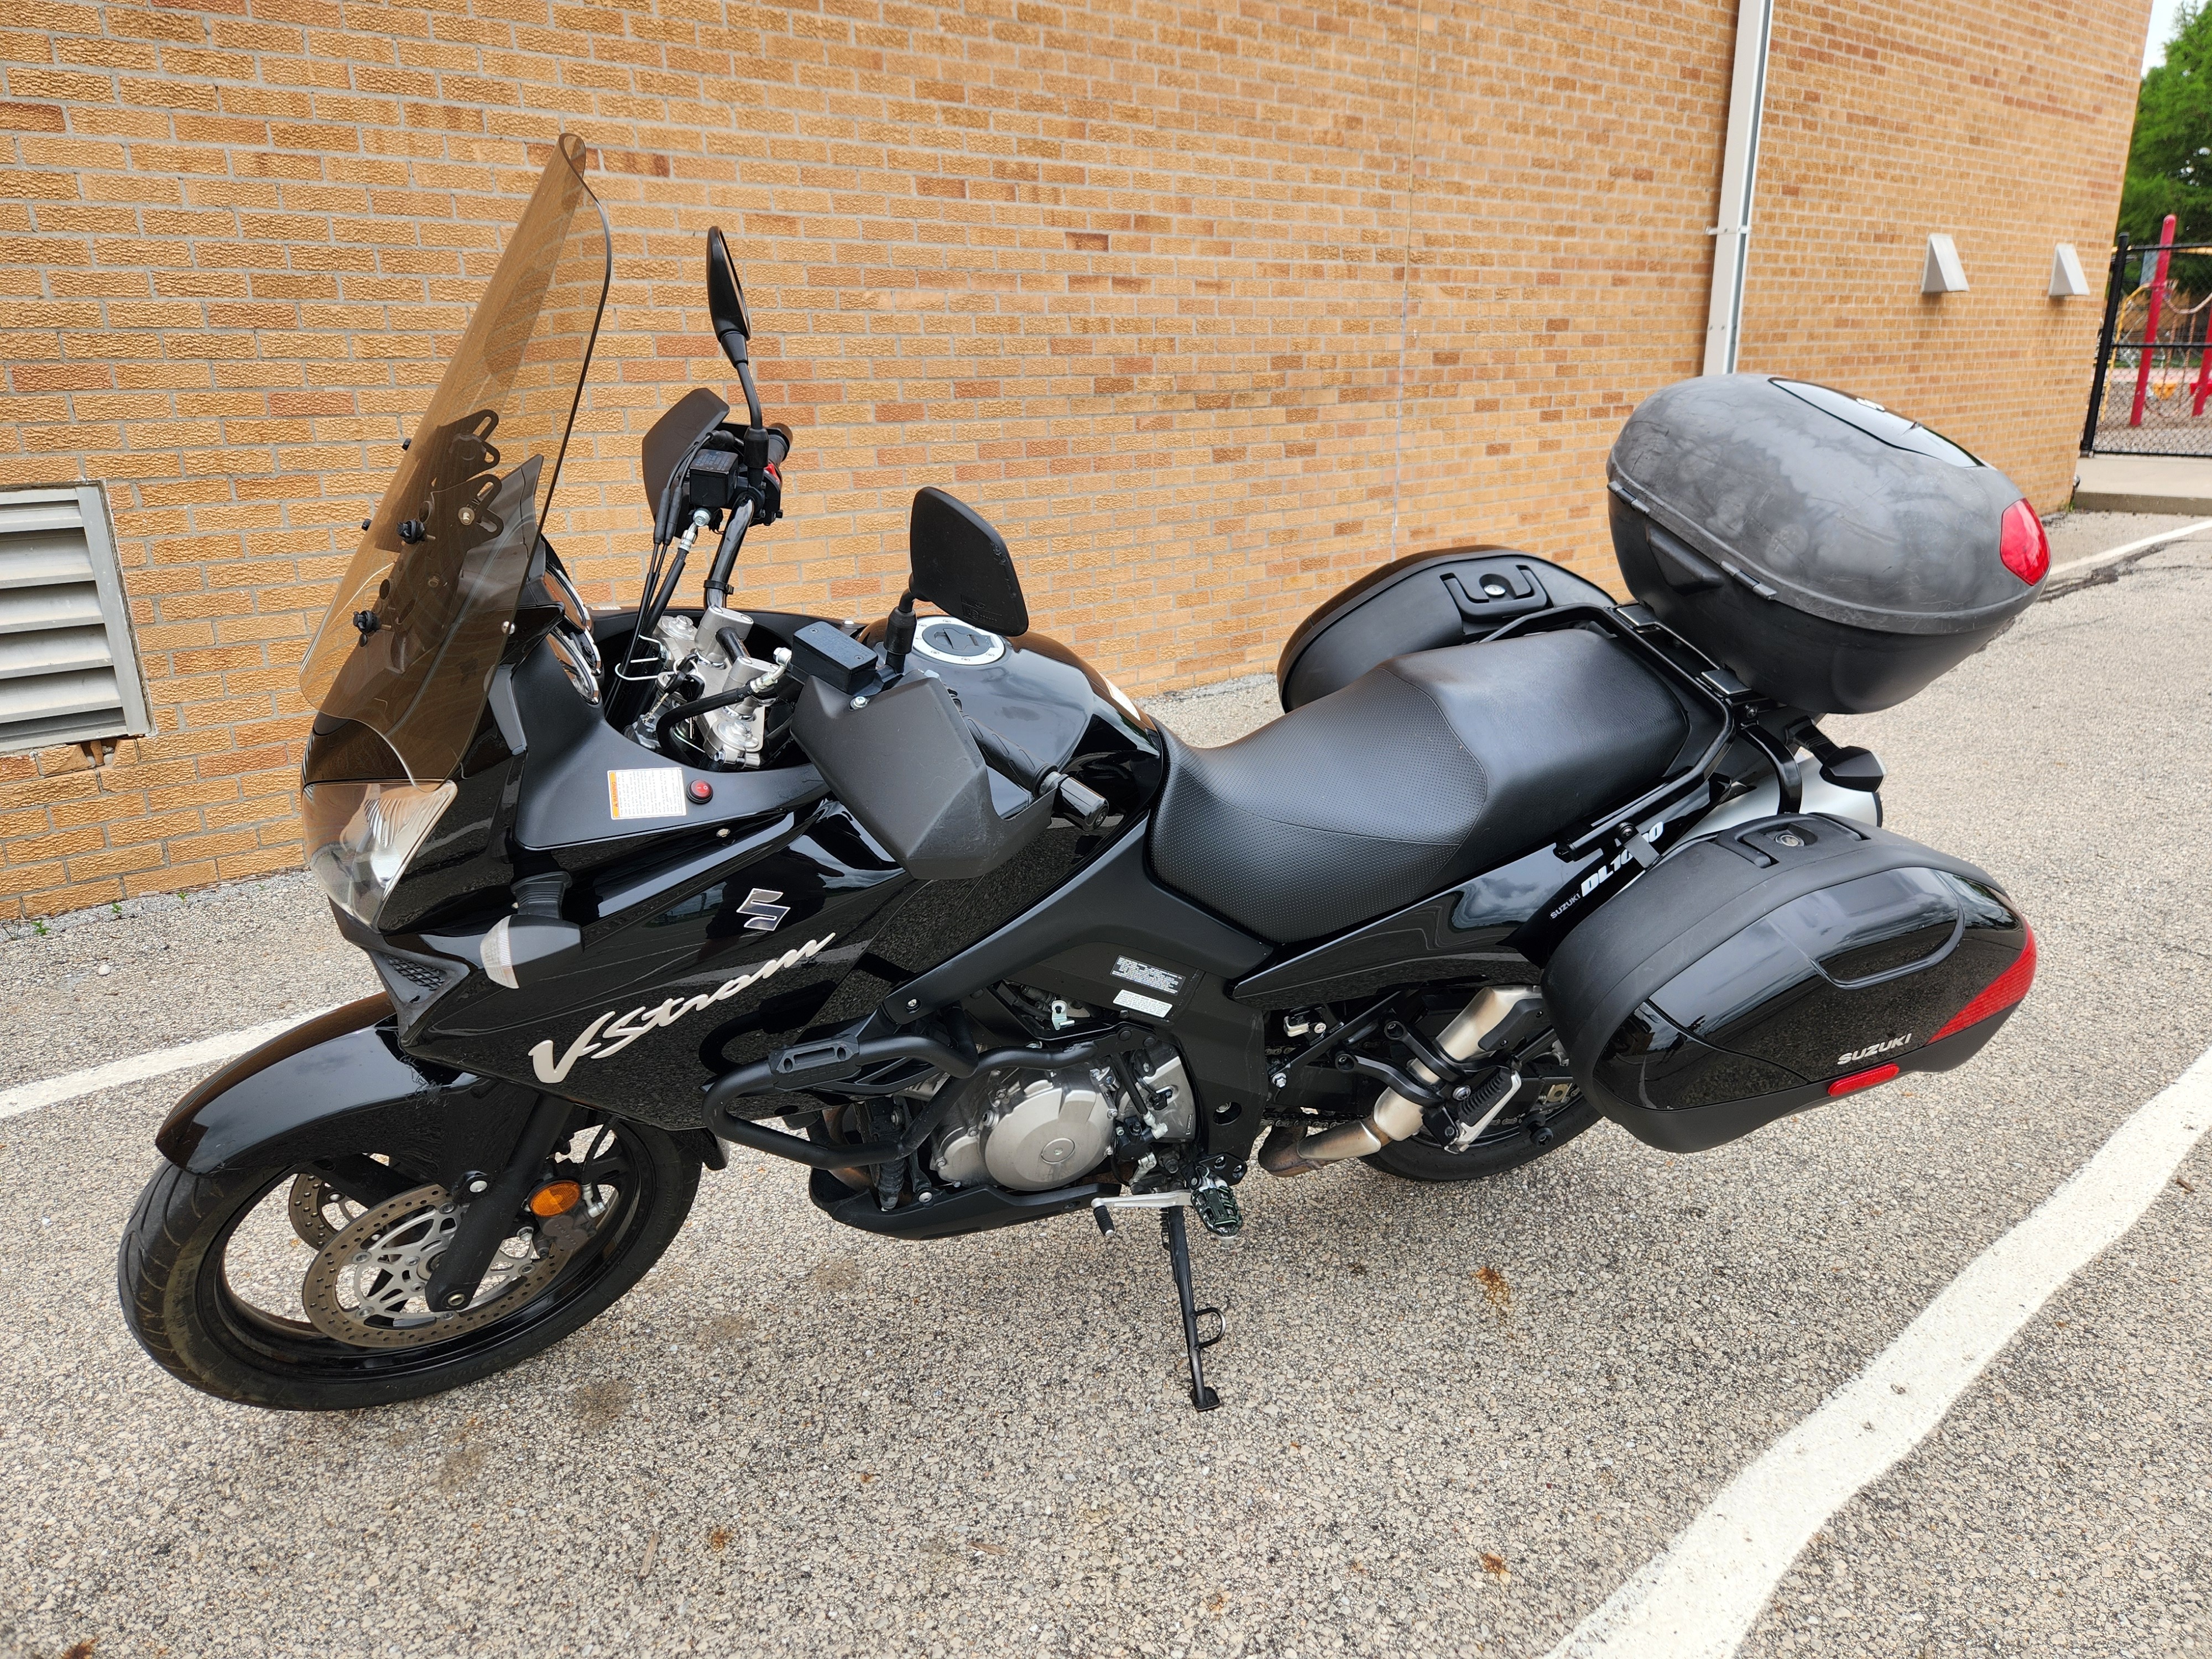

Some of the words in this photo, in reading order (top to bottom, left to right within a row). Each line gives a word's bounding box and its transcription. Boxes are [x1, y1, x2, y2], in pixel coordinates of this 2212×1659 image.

[1550, 893, 1581, 919] SUZUKI
[1582, 821, 1663, 897] DL100
[1837, 1032, 1912, 1065] SUZUKI
